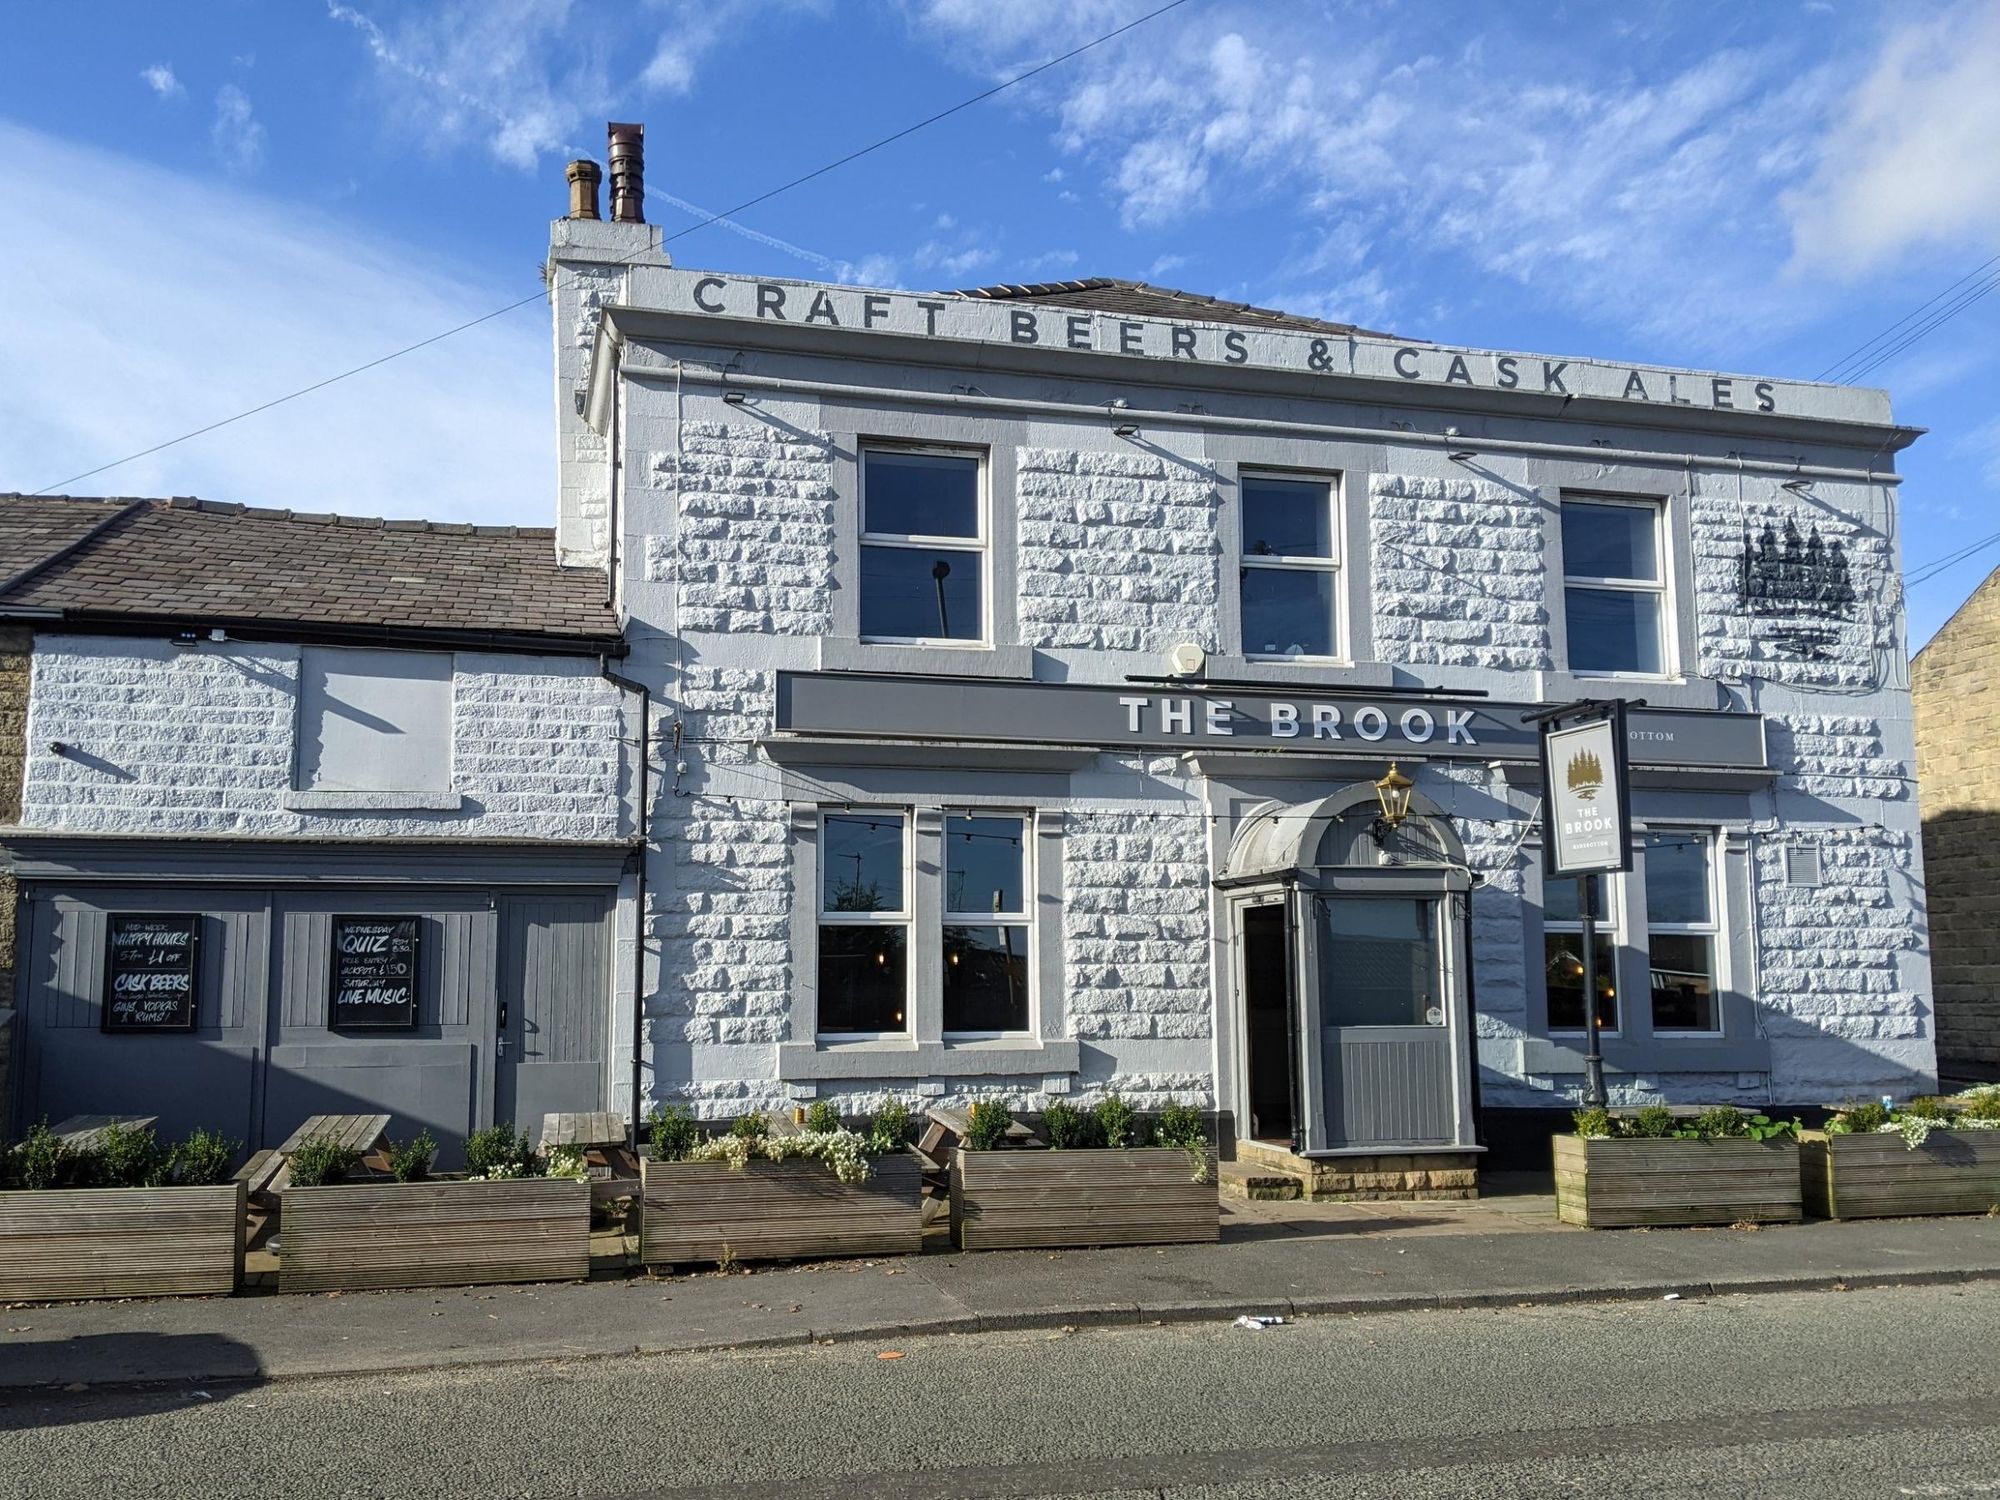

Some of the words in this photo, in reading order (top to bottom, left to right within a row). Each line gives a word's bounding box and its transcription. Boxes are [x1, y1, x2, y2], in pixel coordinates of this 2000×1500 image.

[693, 277, 945, 335] CRAFT
[1010, 310, 1249, 364] BEERS
[1307, 339, 1334, 373] &
[1393, 347, 1569, 395] CASK
[1622, 371, 1775, 412] ALES
[1119, 697, 1234, 735] THE
[1270, 702, 1477, 745] BROOK
[1629, 730, 1674, 741] OTTOM
[1577, 806, 1598, 818] THE
[1565, 816, 1613, 835] BROOK
[344, 926, 396, 934] WEDNESDAY
[118, 932, 153, 946] HAPPY
[152, 932, 190, 946] HOURS
[342, 934, 390, 954] QUIZ
[114, 973, 151, 992] CASK
[149, 973, 190, 992] BEERS
[337, 989, 365, 1005] LIVE
[143, 1000, 179, 1012] VODKAS
